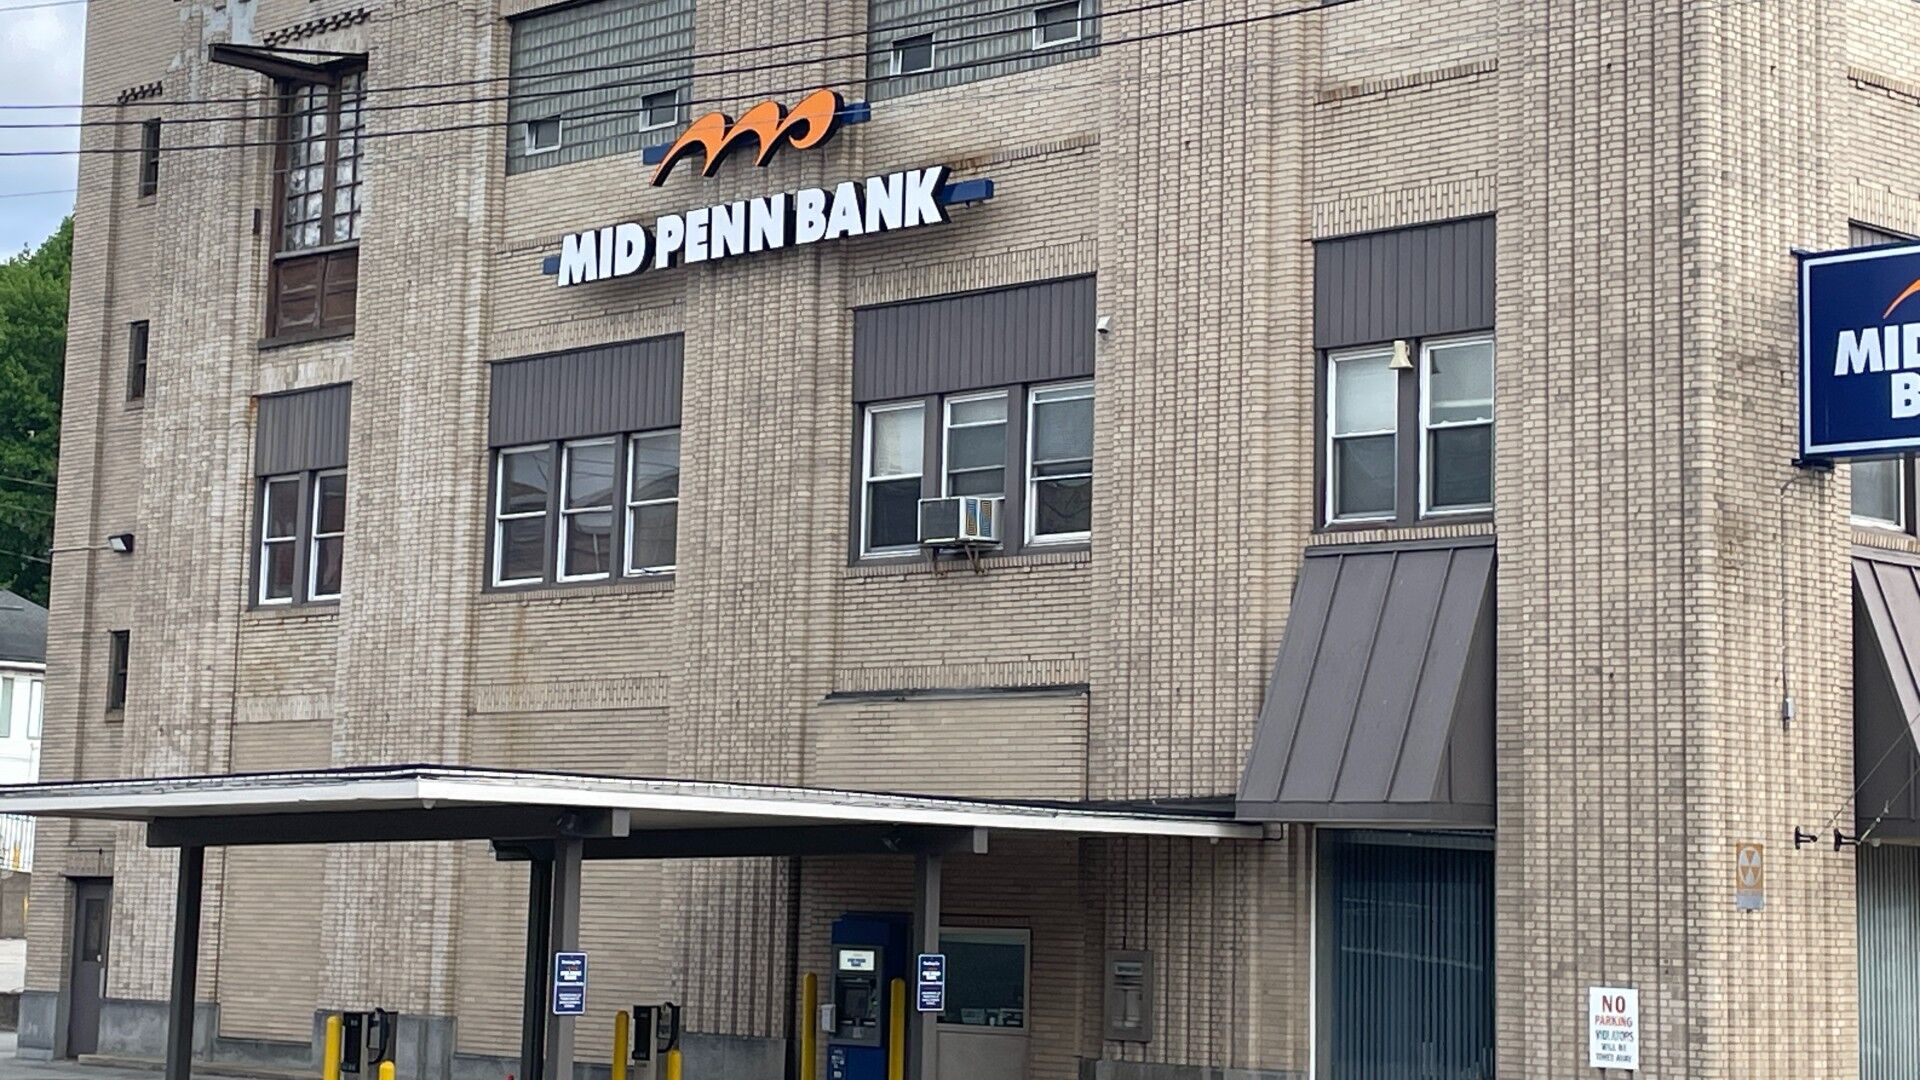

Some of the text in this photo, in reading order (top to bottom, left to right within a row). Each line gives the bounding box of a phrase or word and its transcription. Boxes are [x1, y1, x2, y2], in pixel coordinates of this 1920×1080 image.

[557, 165, 944, 287] MID PENN BANK
[1602, 995, 1626, 1013] NO
[1594, 1014, 1633, 1028] PARKING
